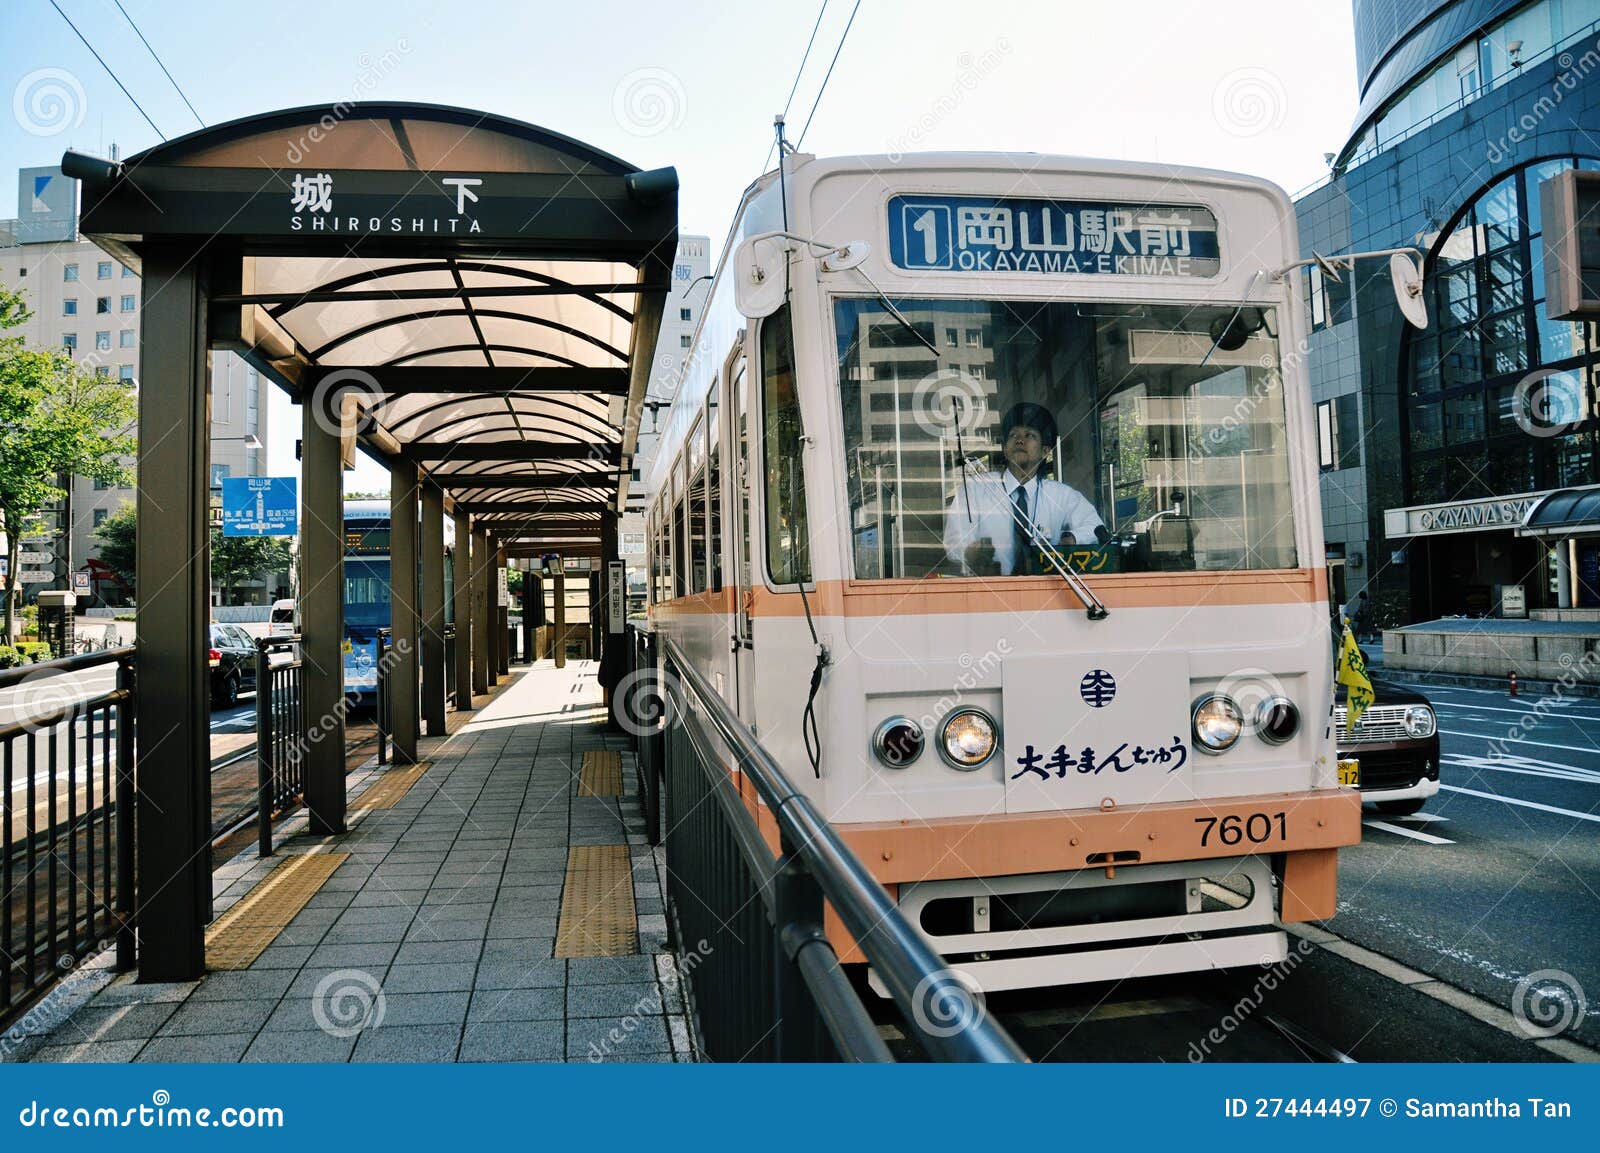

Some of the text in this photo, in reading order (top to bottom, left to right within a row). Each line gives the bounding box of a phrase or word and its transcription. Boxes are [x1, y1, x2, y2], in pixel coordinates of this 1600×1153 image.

[290, 216, 482, 233] SHIROSHITA
[956, 205, 1192, 256] 岡山駅前
[958, 250, 1192, 276] OKAYAMA-EKIMAE
[1421, 503, 1499, 530] OKAYAMA
[1194, 811, 1287, 848] 7601
